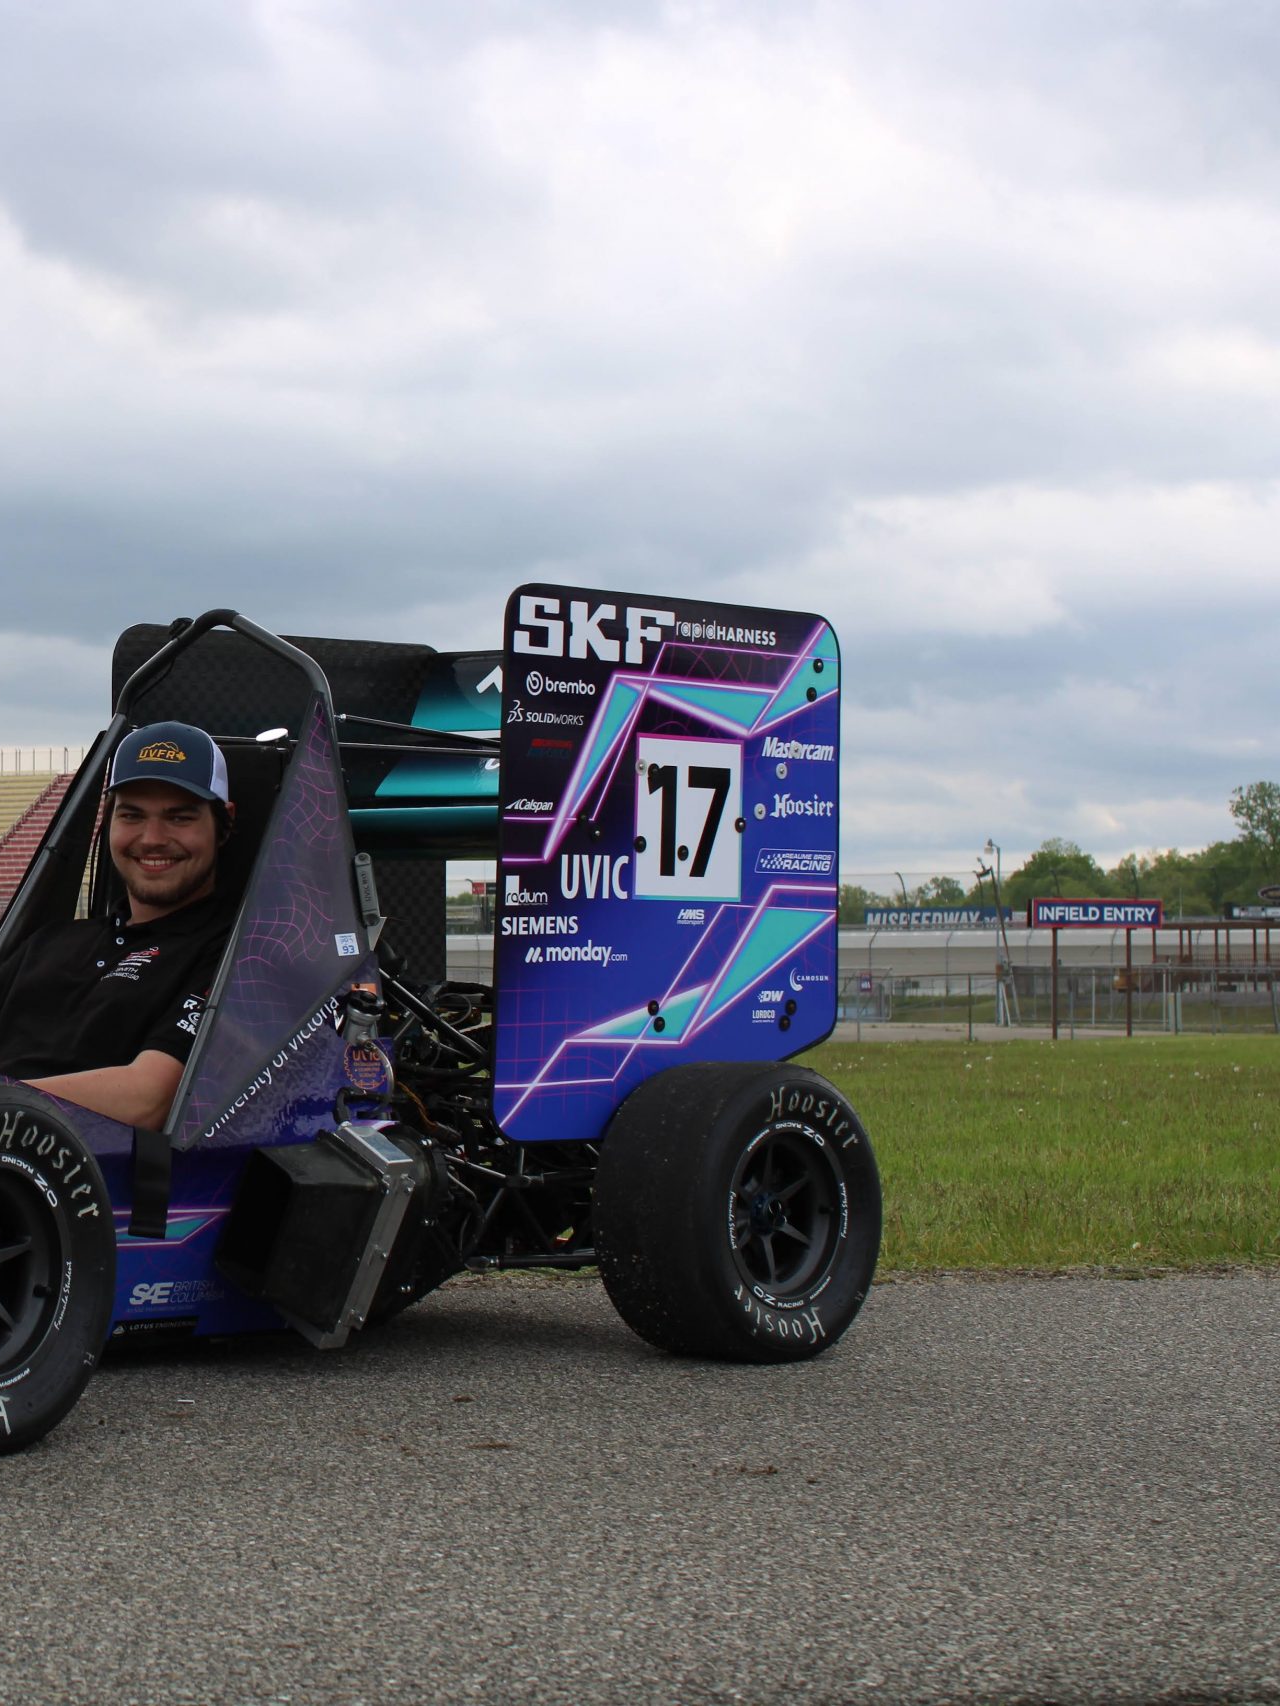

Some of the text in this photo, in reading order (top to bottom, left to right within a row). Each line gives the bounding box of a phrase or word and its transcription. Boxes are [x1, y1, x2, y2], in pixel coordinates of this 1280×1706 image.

[513, 595, 675, 664] SKF
[676, 618, 777, 647] rapidHARNESS
[545, 676, 596, 695] brembo
[525, 711, 585, 726] SOLIDWORKS
[138, 748, 176, 760] UVFR
[761, 736, 835, 762] Mastrcam
[519, 798, 554, 813] Calspan
[769, 792, 834, 819] Hoosier
[647, 763, 732, 878] 17
[782, 859, 831, 872] RACING
[560, 854, 630, 900] UVIC
[677, 908, 705, 920] HMS
[1038, 906, 1156, 922] INFIELD ENTRY
[501, 916, 579, 935] SIEMENS
[546, 939, 628, 967] monday.com
[176, 1019, 197, 1036] SK
[766, 1086, 859, 1148] Hoosier
[1, 1155, 35, 1175] RACING
[128, 1281, 174, 1305] SAE
